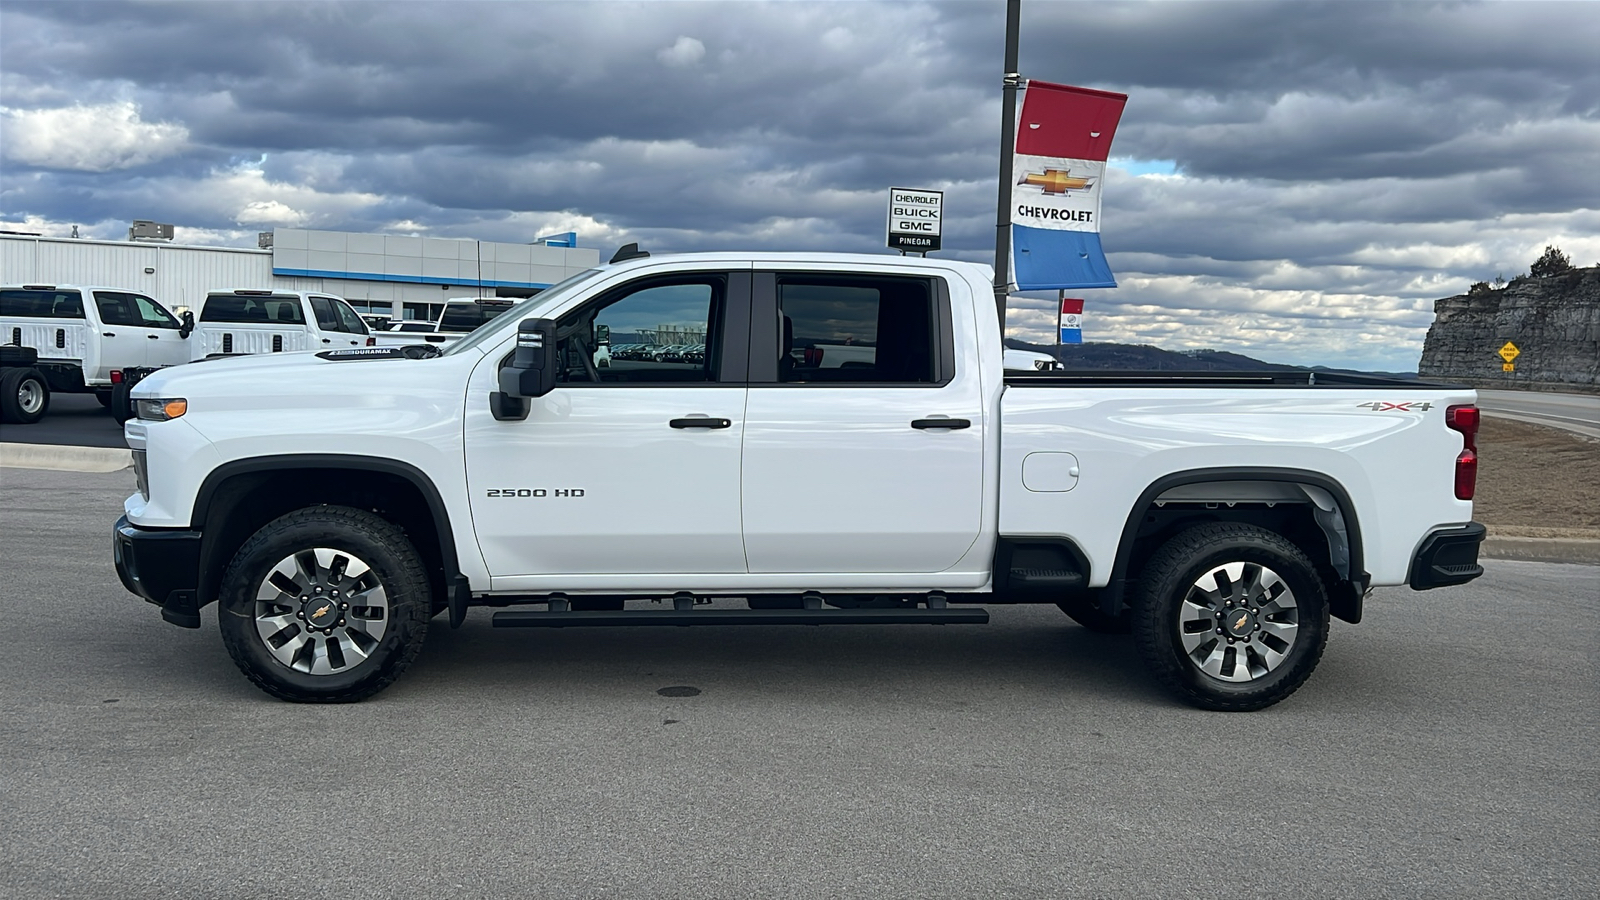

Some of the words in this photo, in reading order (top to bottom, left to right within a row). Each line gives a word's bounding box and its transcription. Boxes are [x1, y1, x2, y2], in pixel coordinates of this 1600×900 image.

[895, 194, 939, 205] CHEVROLET
[894, 207, 939, 218] BUICK
[1018, 205, 1093, 222] CHEVROLET
[899, 221, 933, 231] GMC
[899, 237, 932, 246] PINEGAR
[486, 488, 547, 497] 2500
[554, 488, 585, 497] HD
